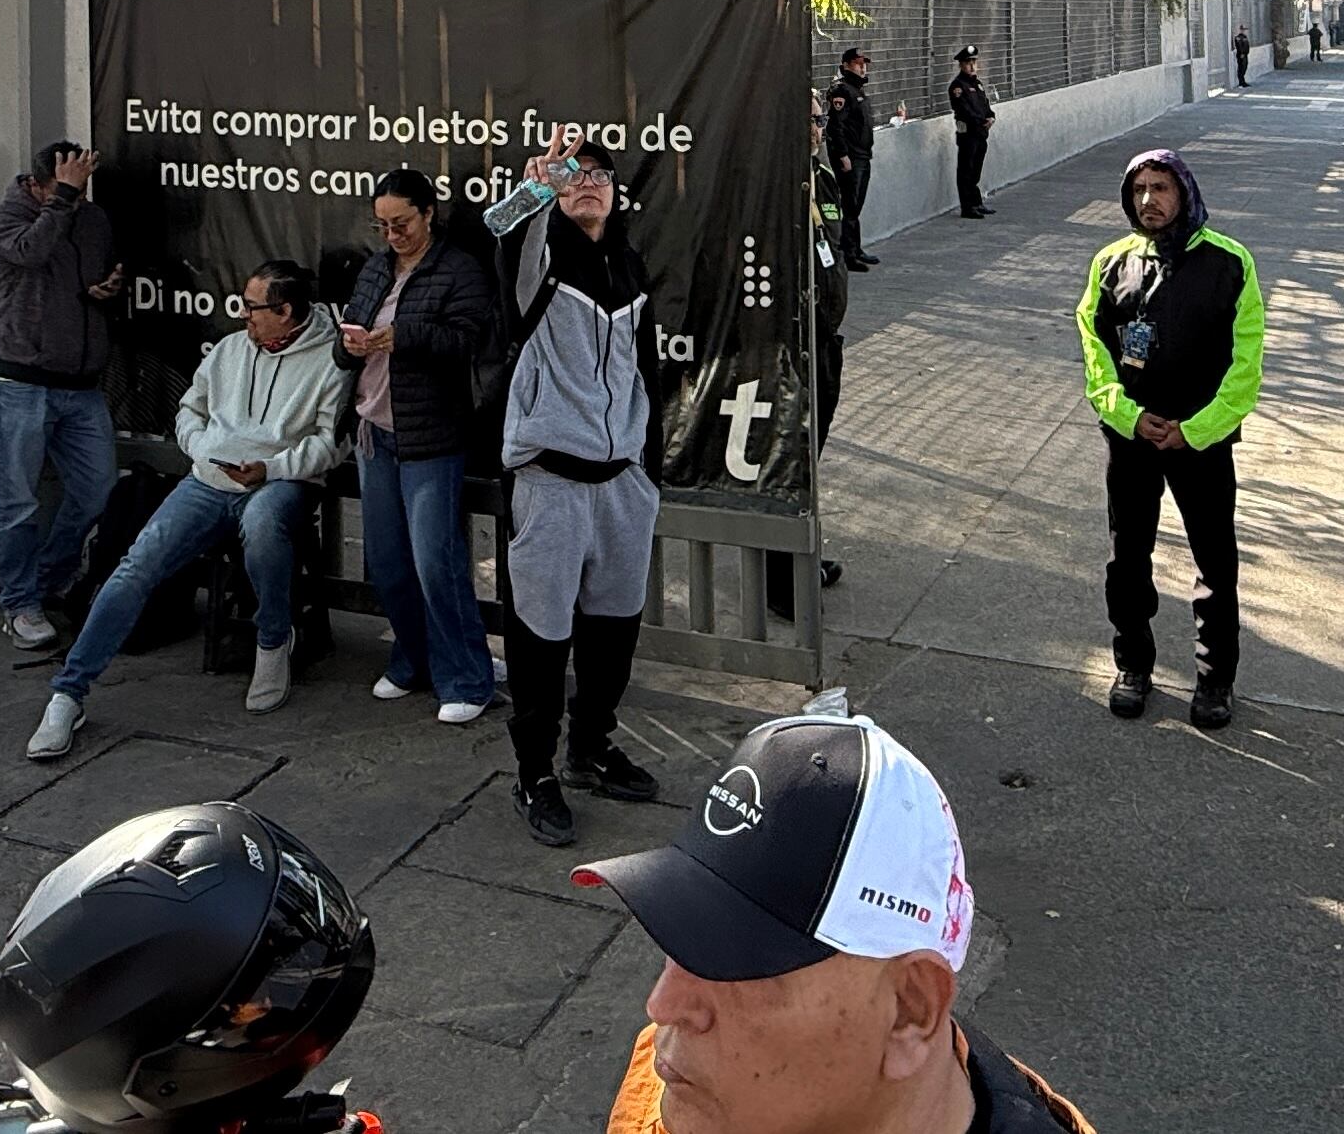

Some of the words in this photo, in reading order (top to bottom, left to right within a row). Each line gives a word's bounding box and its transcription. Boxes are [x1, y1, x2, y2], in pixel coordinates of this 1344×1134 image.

[126, 98, 202, 134] Evita
[212, 110, 357, 147] comprar
[368, 104, 508, 146] boletos
[522, 108, 627, 149] fuera
[640, 112, 693, 153] de
[160, 158, 301, 193] nuestros
[174, 289, 215, 316] no
[709, 784, 762, 825] NISSAN
